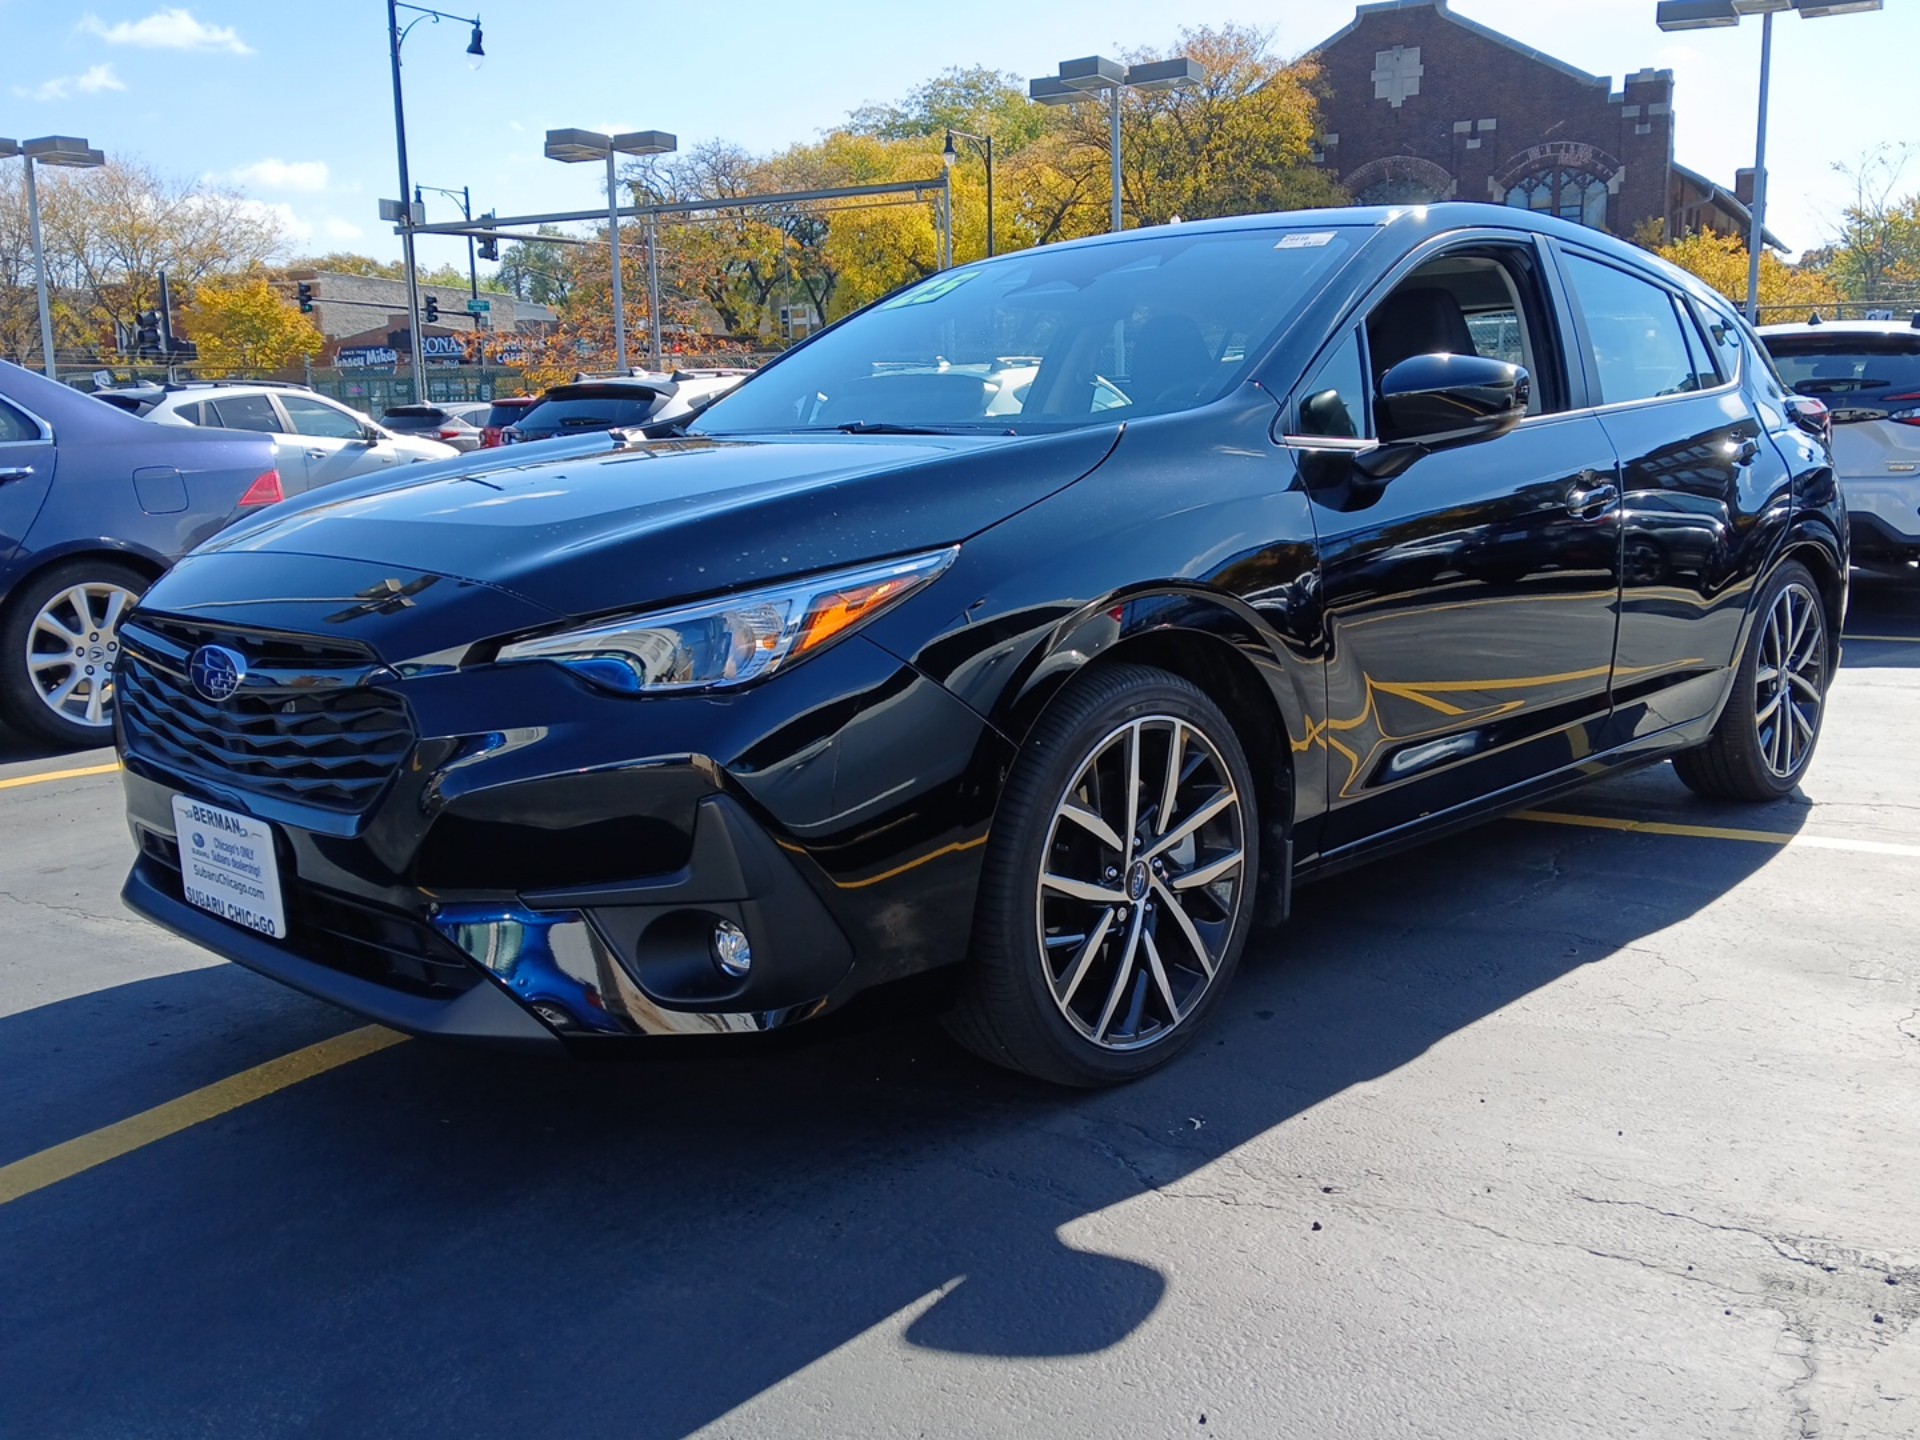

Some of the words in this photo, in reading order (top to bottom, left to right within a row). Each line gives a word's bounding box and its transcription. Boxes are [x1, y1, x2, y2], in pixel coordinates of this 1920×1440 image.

[192, 804, 240, 834] BERMAN
[211, 850, 230, 867] Subaru
[213, 837, 240, 856] Chicago's
[240, 846, 254, 861] ONLY
[193, 864, 265, 900] SubaruChicago.com
[187, 886, 225, 915] SUBARU
[228, 903, 276, 936] CHICAGO
